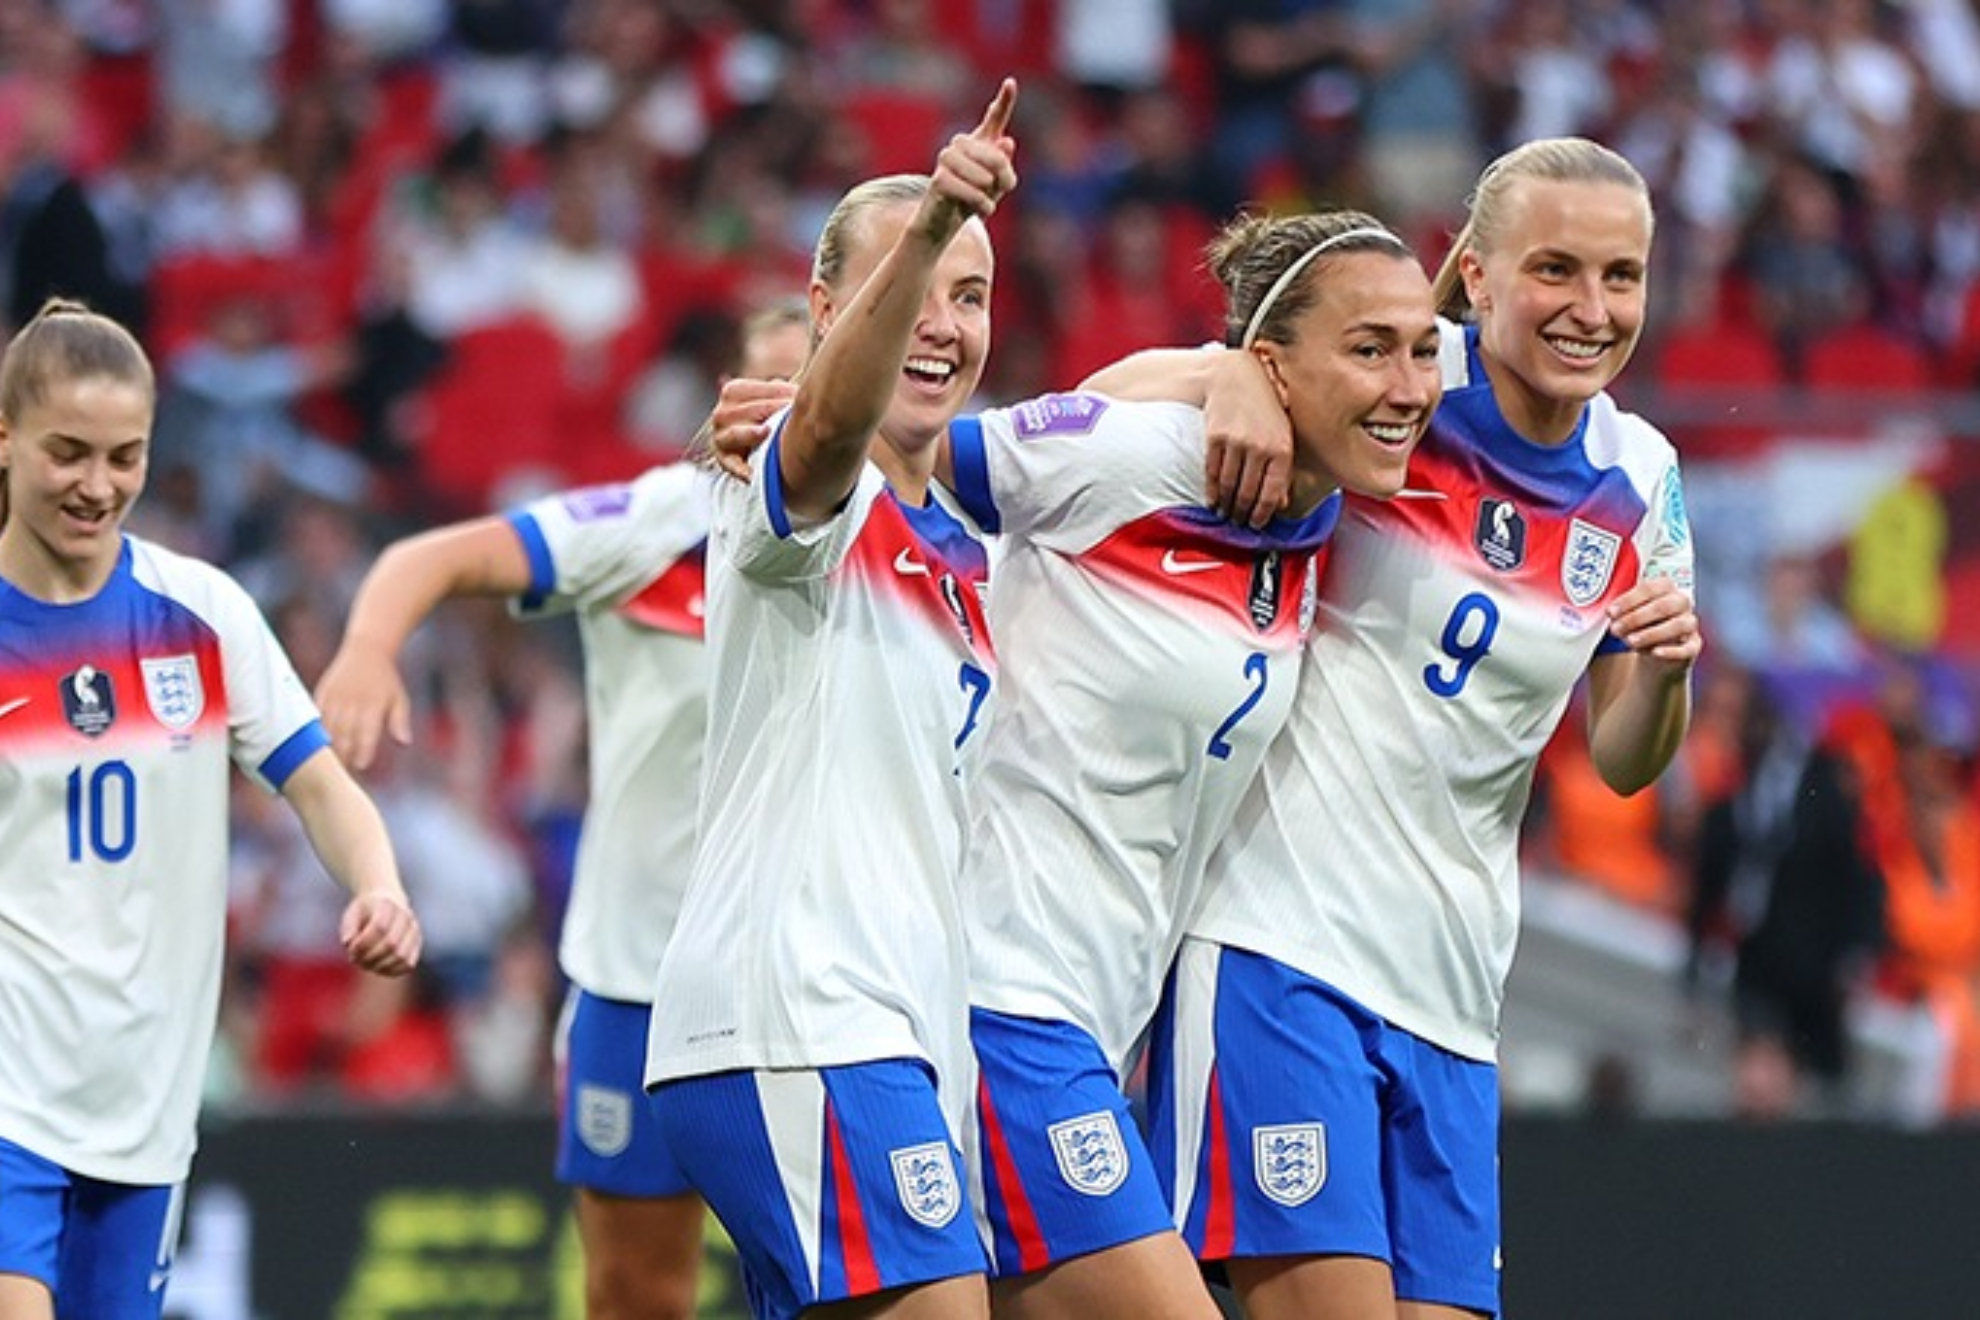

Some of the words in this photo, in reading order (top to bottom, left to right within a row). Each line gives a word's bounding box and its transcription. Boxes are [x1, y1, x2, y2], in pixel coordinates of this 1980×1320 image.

[1423, 592, 1500, 698] 9
[955, 661, 991, 751] 7
[1206, 652, 1268, 761] 2
[66, 760, 137, 864] 10
